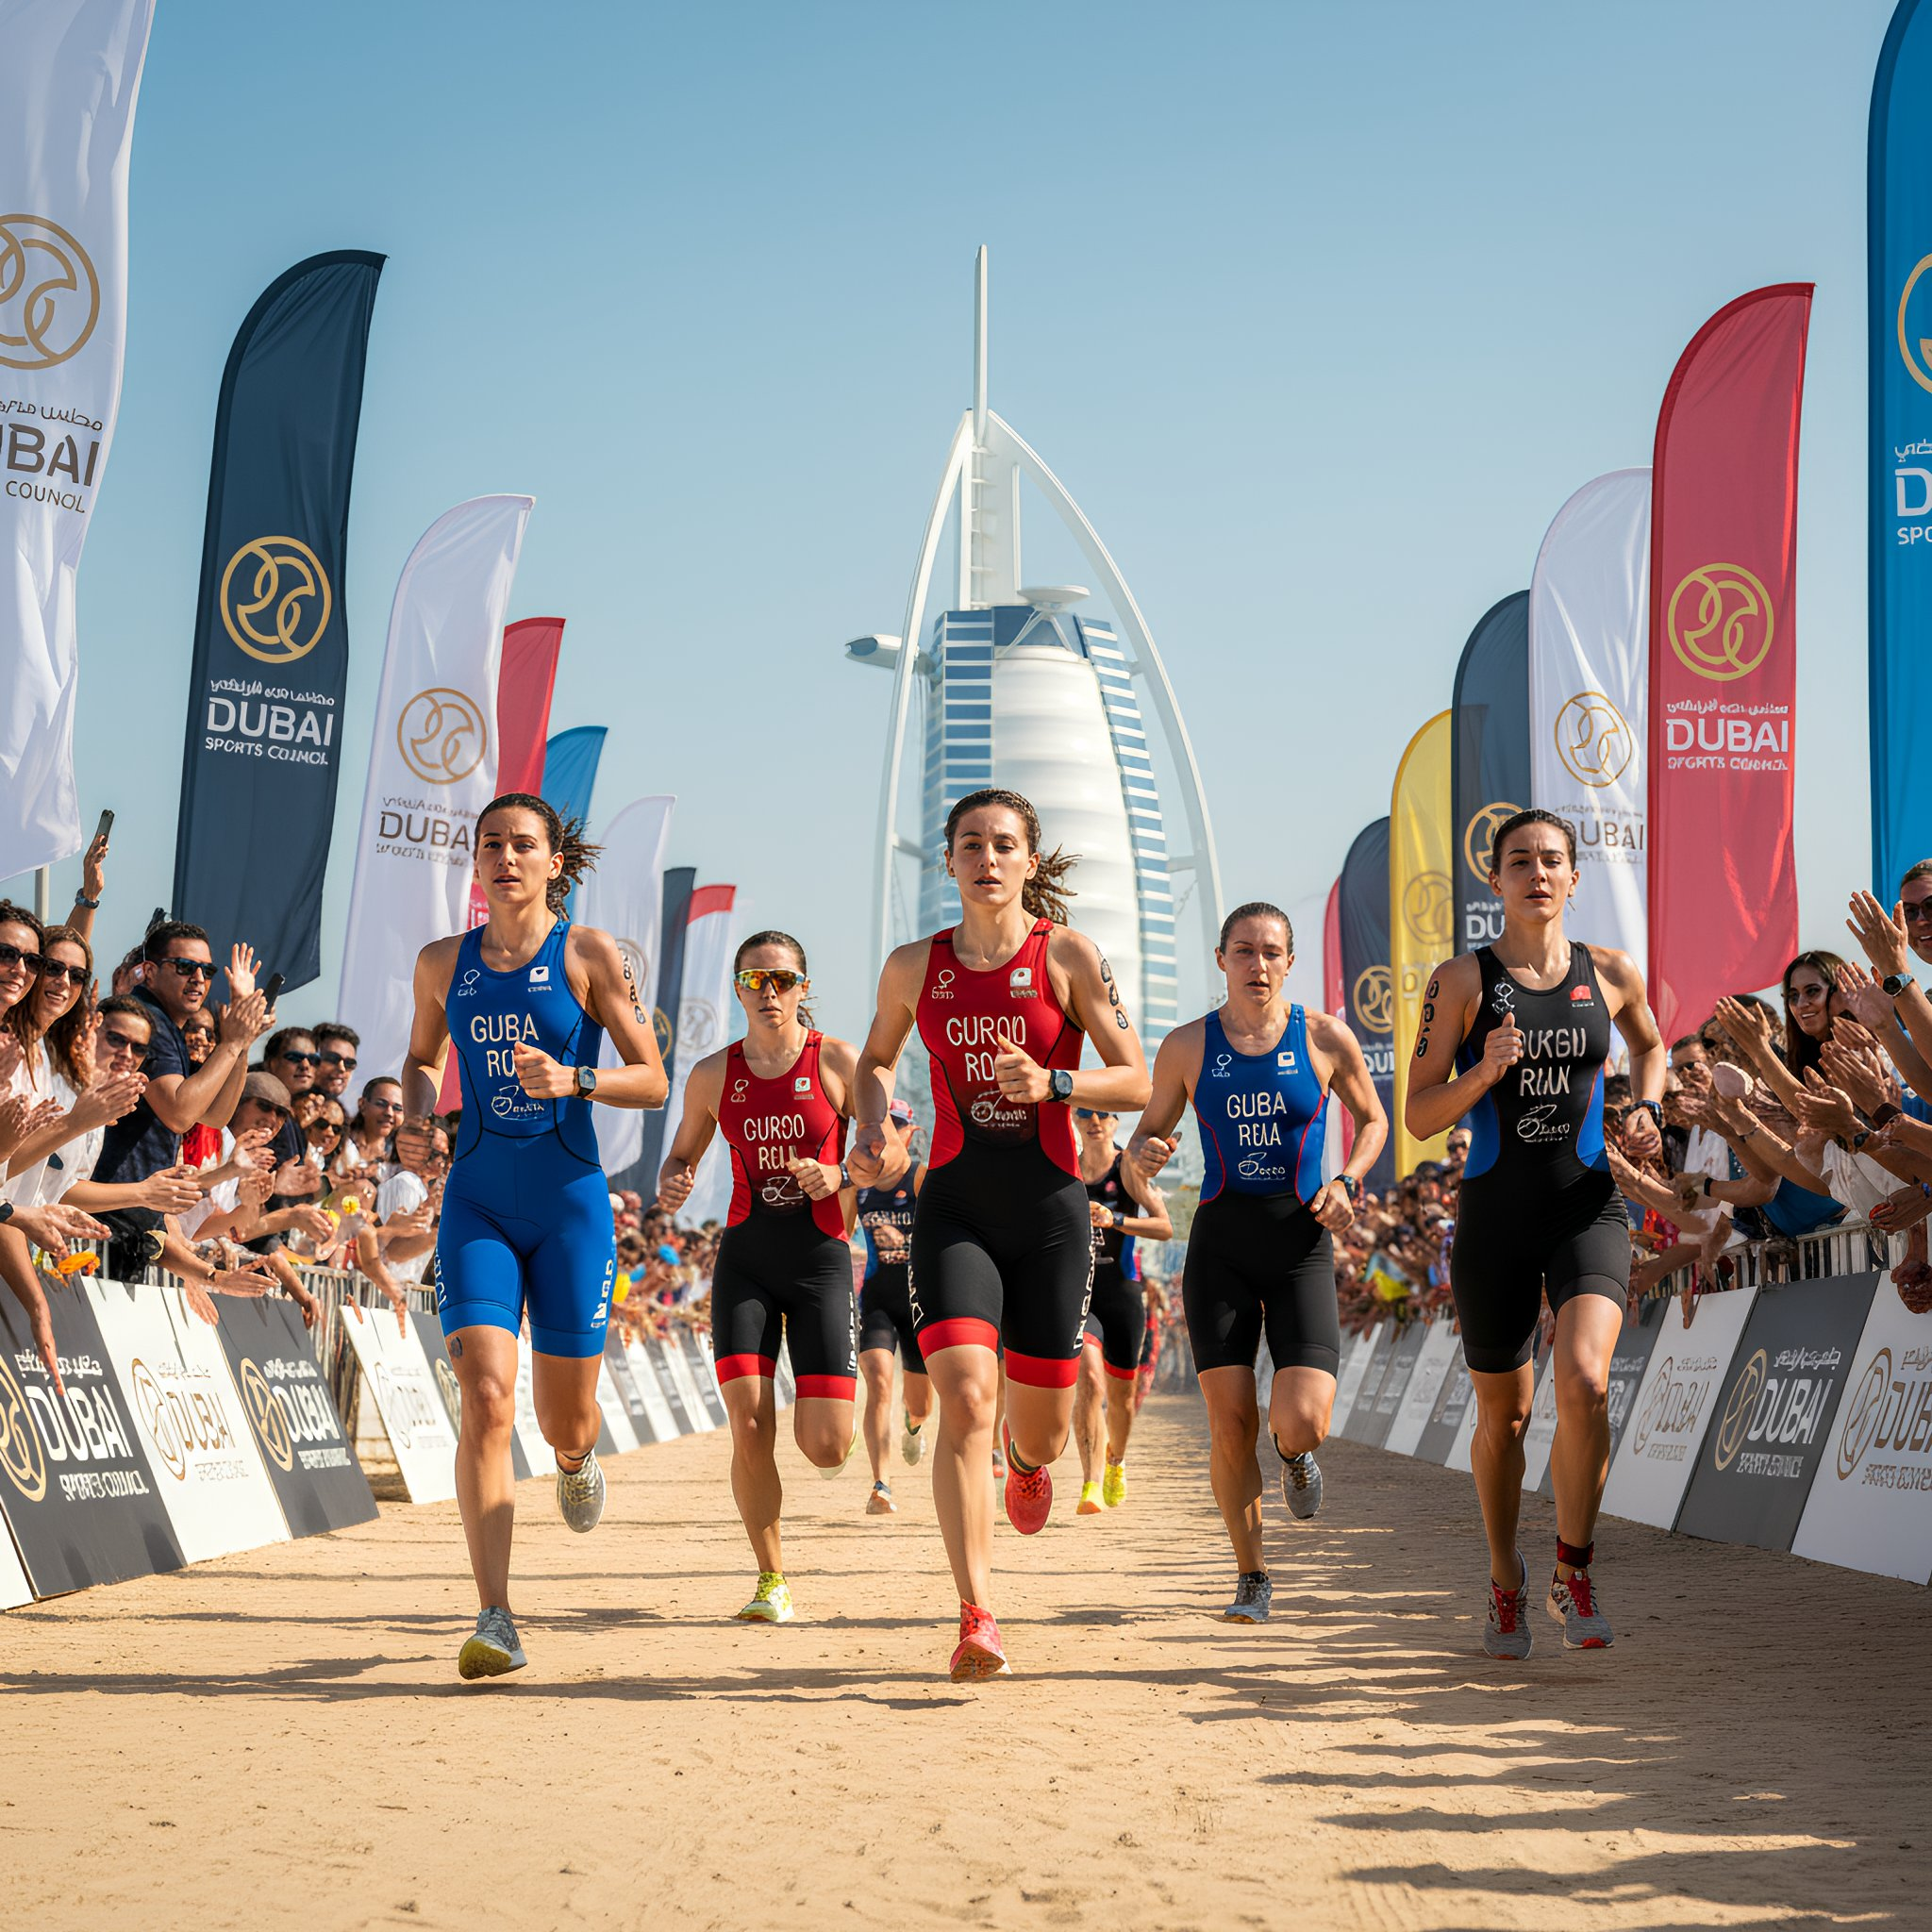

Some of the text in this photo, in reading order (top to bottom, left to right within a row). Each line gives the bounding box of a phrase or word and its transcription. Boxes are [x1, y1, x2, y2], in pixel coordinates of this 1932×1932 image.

[0, 423, 100, 487] BAI
[207, 696, 334, 746] DUBAI
[1666, 718, 1789, 753] DUBAI
[471, 1012, 540, 1043] GUBA
[1226, 1091, 1287, 1119] GUBA
[25, 1384, 134, 1461] DUBAI
[1747, 1378, 1834, 1445] DUBAI
[1874, 1381, 1932, 1454] DUB
